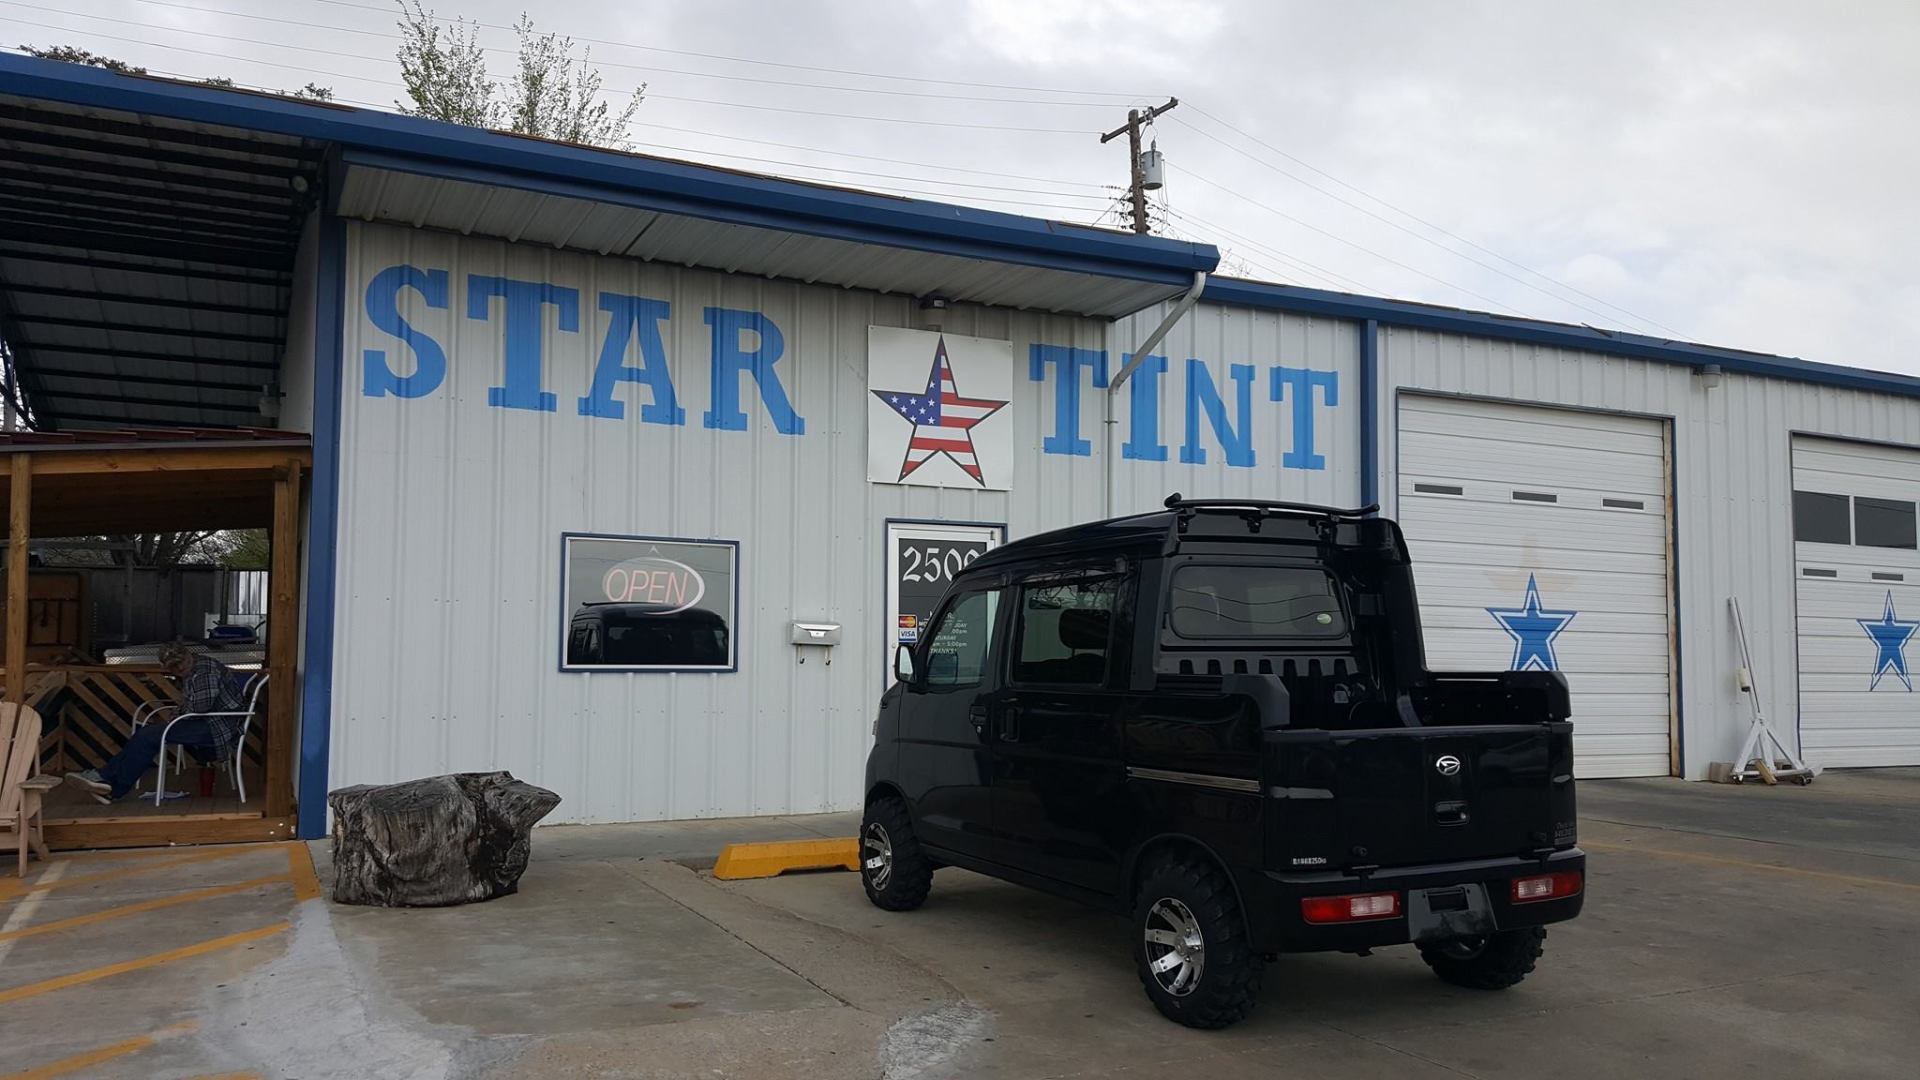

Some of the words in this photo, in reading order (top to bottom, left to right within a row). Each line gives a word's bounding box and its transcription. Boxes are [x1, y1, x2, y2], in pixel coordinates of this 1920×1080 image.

[363, 264, 805, 435] STAR
[1029, 343, 1338, 470] TINT
[606, 568, 688, 604] OPEN
